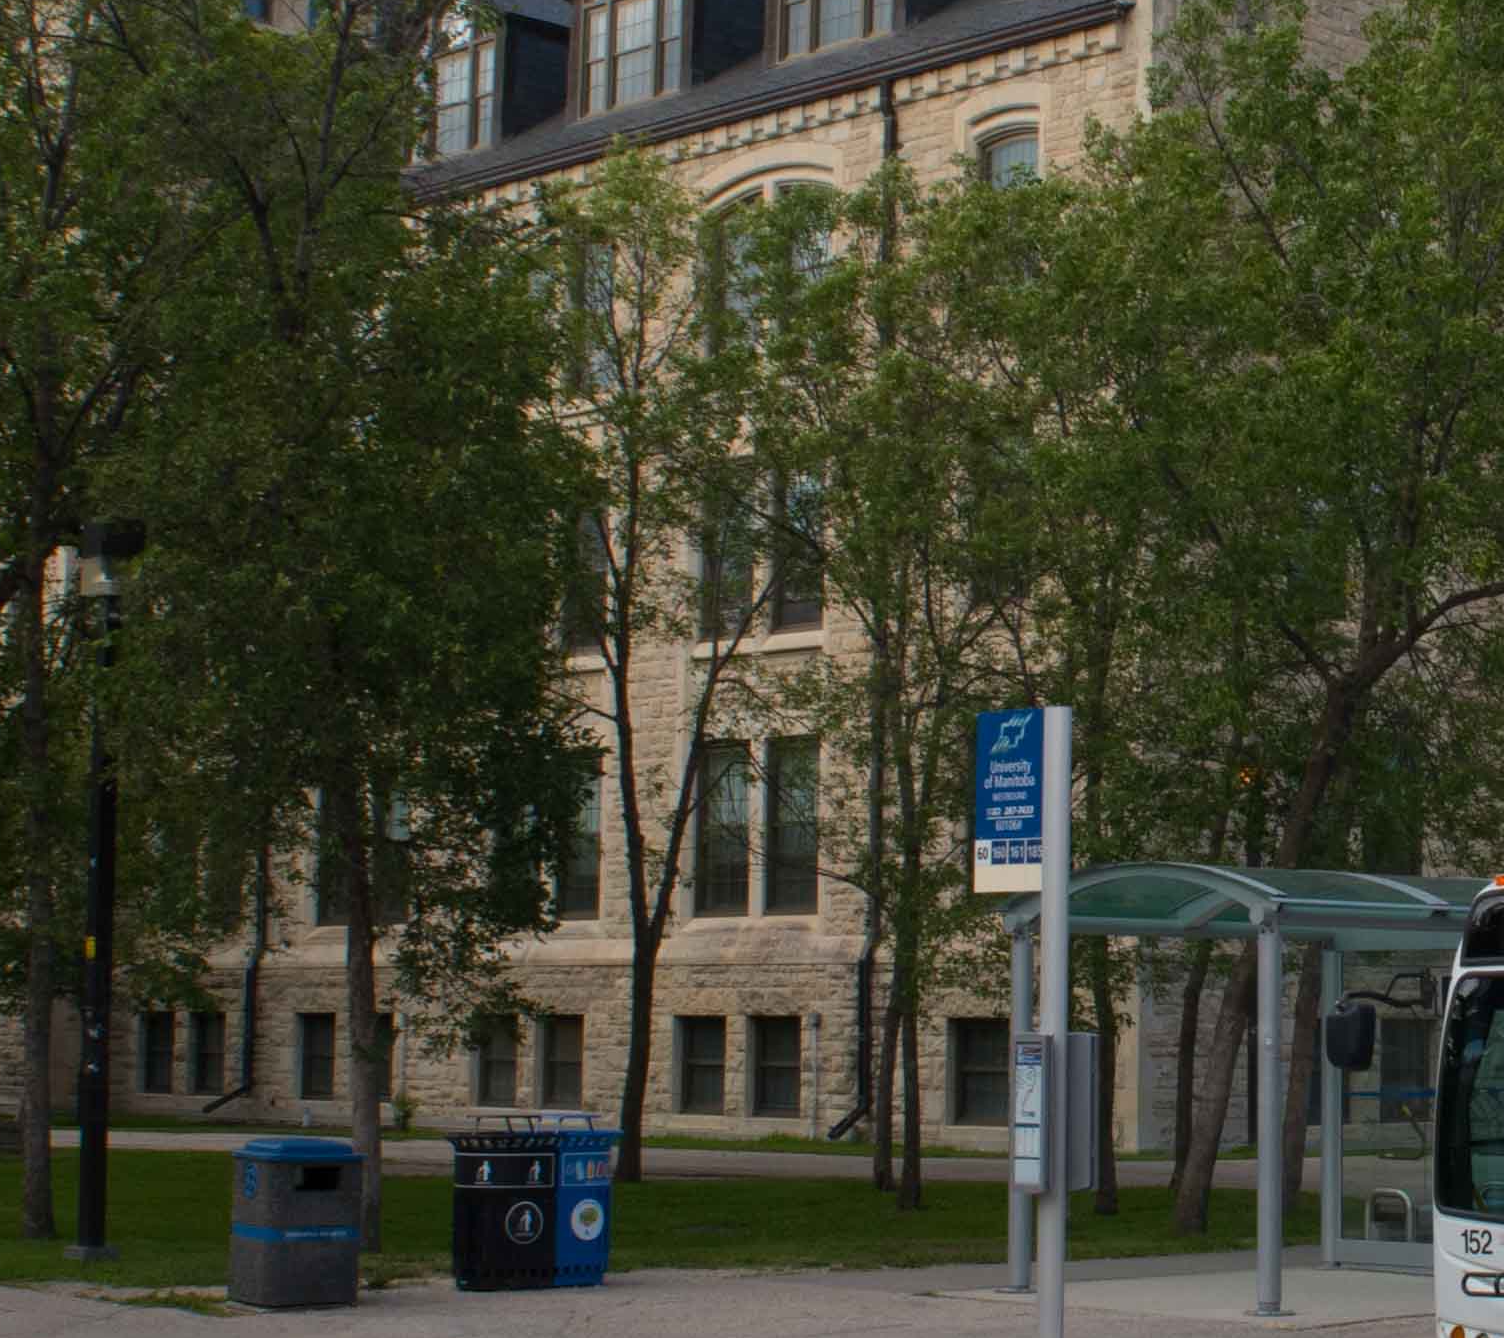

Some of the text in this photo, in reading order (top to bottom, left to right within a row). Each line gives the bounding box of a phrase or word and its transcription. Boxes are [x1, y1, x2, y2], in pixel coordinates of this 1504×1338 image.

[989, 760, 1033, 774] University
[984, 774, 1036, 789] of Manitoba
[977, 847, 989, 860] 60
[1460, 1228, 1494, 1255] 152
